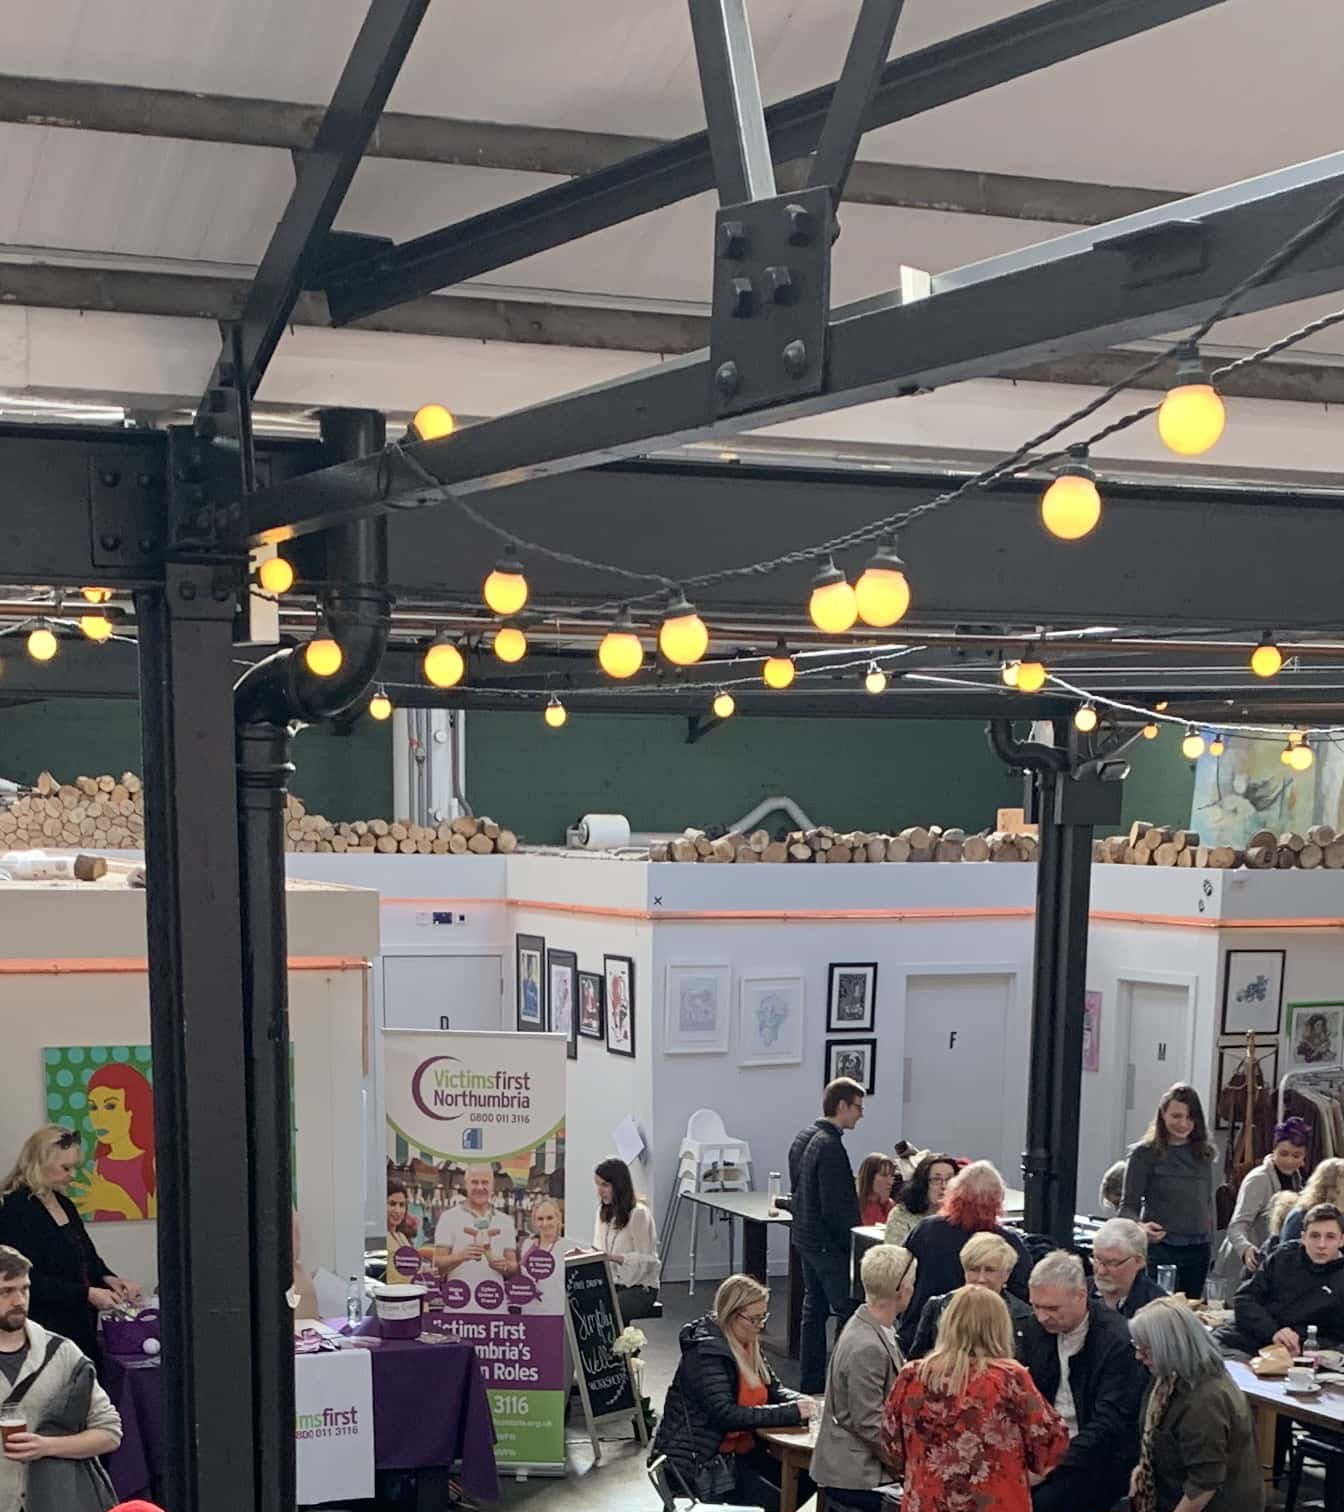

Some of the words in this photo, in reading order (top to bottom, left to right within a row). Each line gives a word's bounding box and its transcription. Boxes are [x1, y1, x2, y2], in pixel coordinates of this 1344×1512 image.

[950, 1031, 957, 1049] F
[434, 1070, 530, 1090] Victimsfirst
[434, 1089, 530, 1109] Northumbria
[470, 1112, 493, 1123] 0800
[496, 1113, 509, 1124] 011
[511, 1114, 530, 1124] 3116
[490, 1321, 526, 1340] First
[474, 1342, 531, 1361] mbria's
[494, 1363, 538, 1381] Roles
[494, 1395, 529, 1415] 3116
[295, 1430, 314, 1440] 800
[316, 1428, 332, 1438] 011
[336, 1425, 358, 1436] 3116
